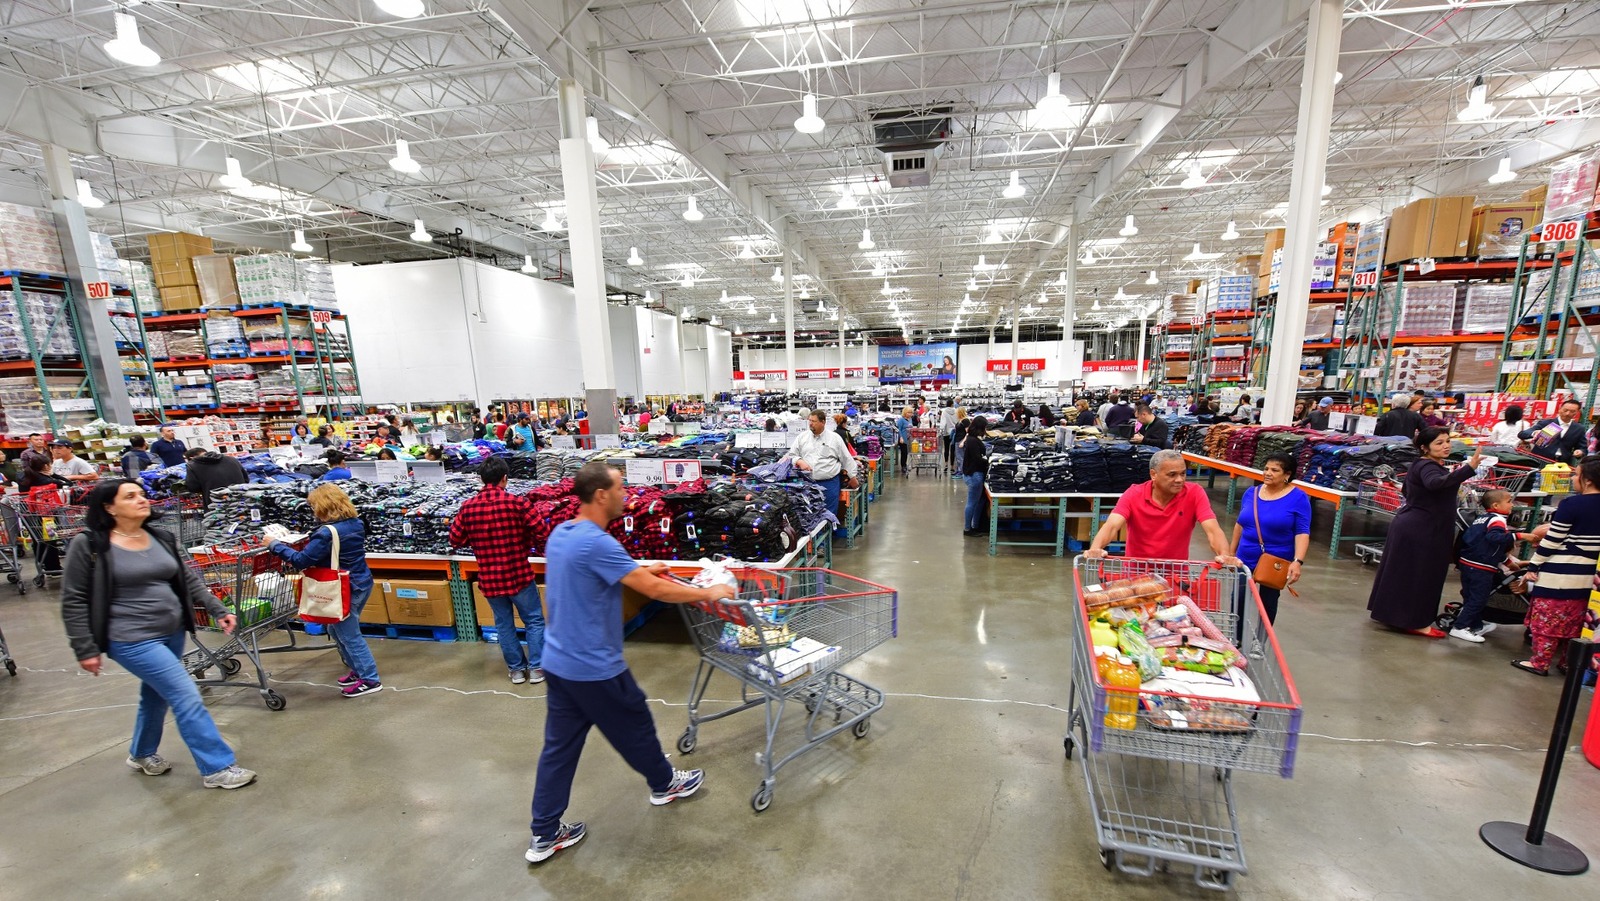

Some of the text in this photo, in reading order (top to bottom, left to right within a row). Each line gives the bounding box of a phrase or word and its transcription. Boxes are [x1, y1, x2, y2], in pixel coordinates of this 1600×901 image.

[1543, 222, 1577, 241] 308
[1355, 272, 1377, 286] 310
[87, 282, 109, 298] 507
[312, 311, 331, 323] 509
[1191, 317, 1204, 325] 314
[993, 363, 1009, 371] MILK
[1022, 362, 1039, 370] EGGS
[1120, 364, 1138, 372] BAKER
[646, 475, 662, 483] 9.99
